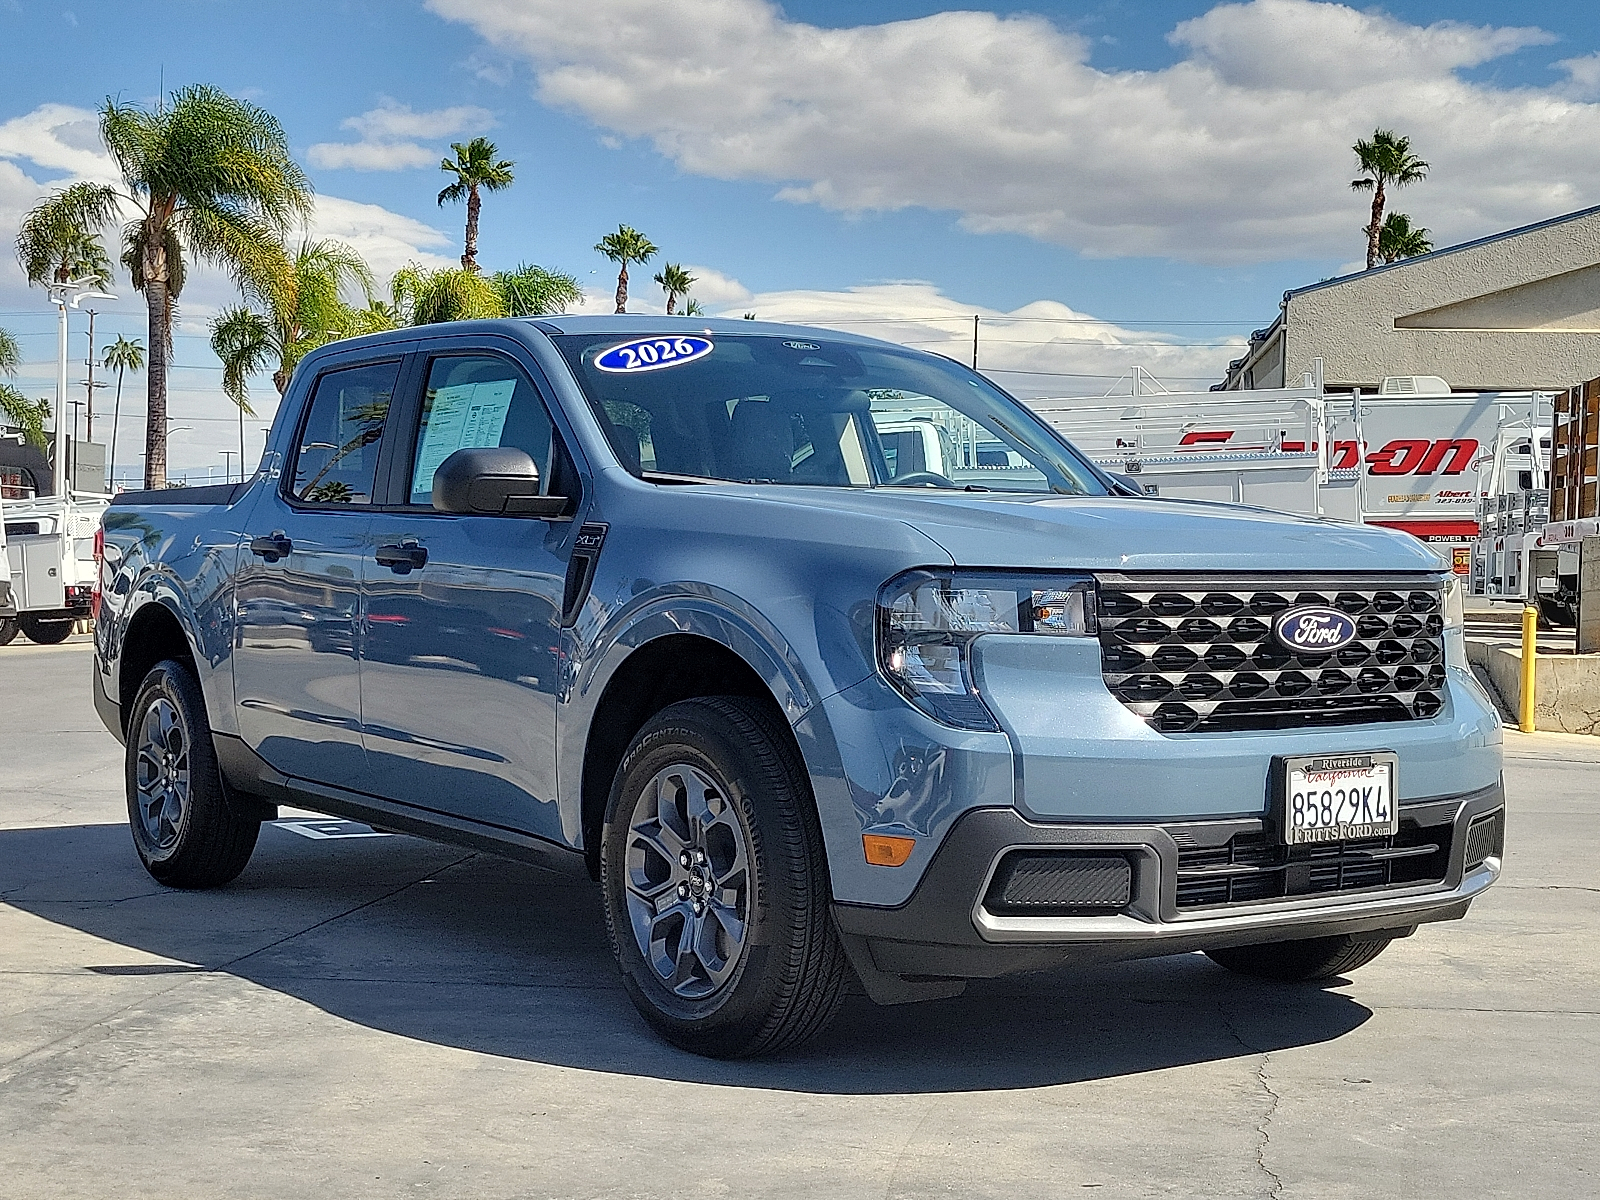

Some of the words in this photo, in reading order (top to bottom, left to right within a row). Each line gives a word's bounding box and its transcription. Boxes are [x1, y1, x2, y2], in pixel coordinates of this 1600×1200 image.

[618, 338, 695, 369] 2026
[1434, 490, 1472, 498] Albert
[575, 535, 600, 545] XLT
[1294, 613, 1343, 646] Ford
[1322, 757, 1363, 770] Riverside
[1292, 785, 1388, 828] 85829K4
